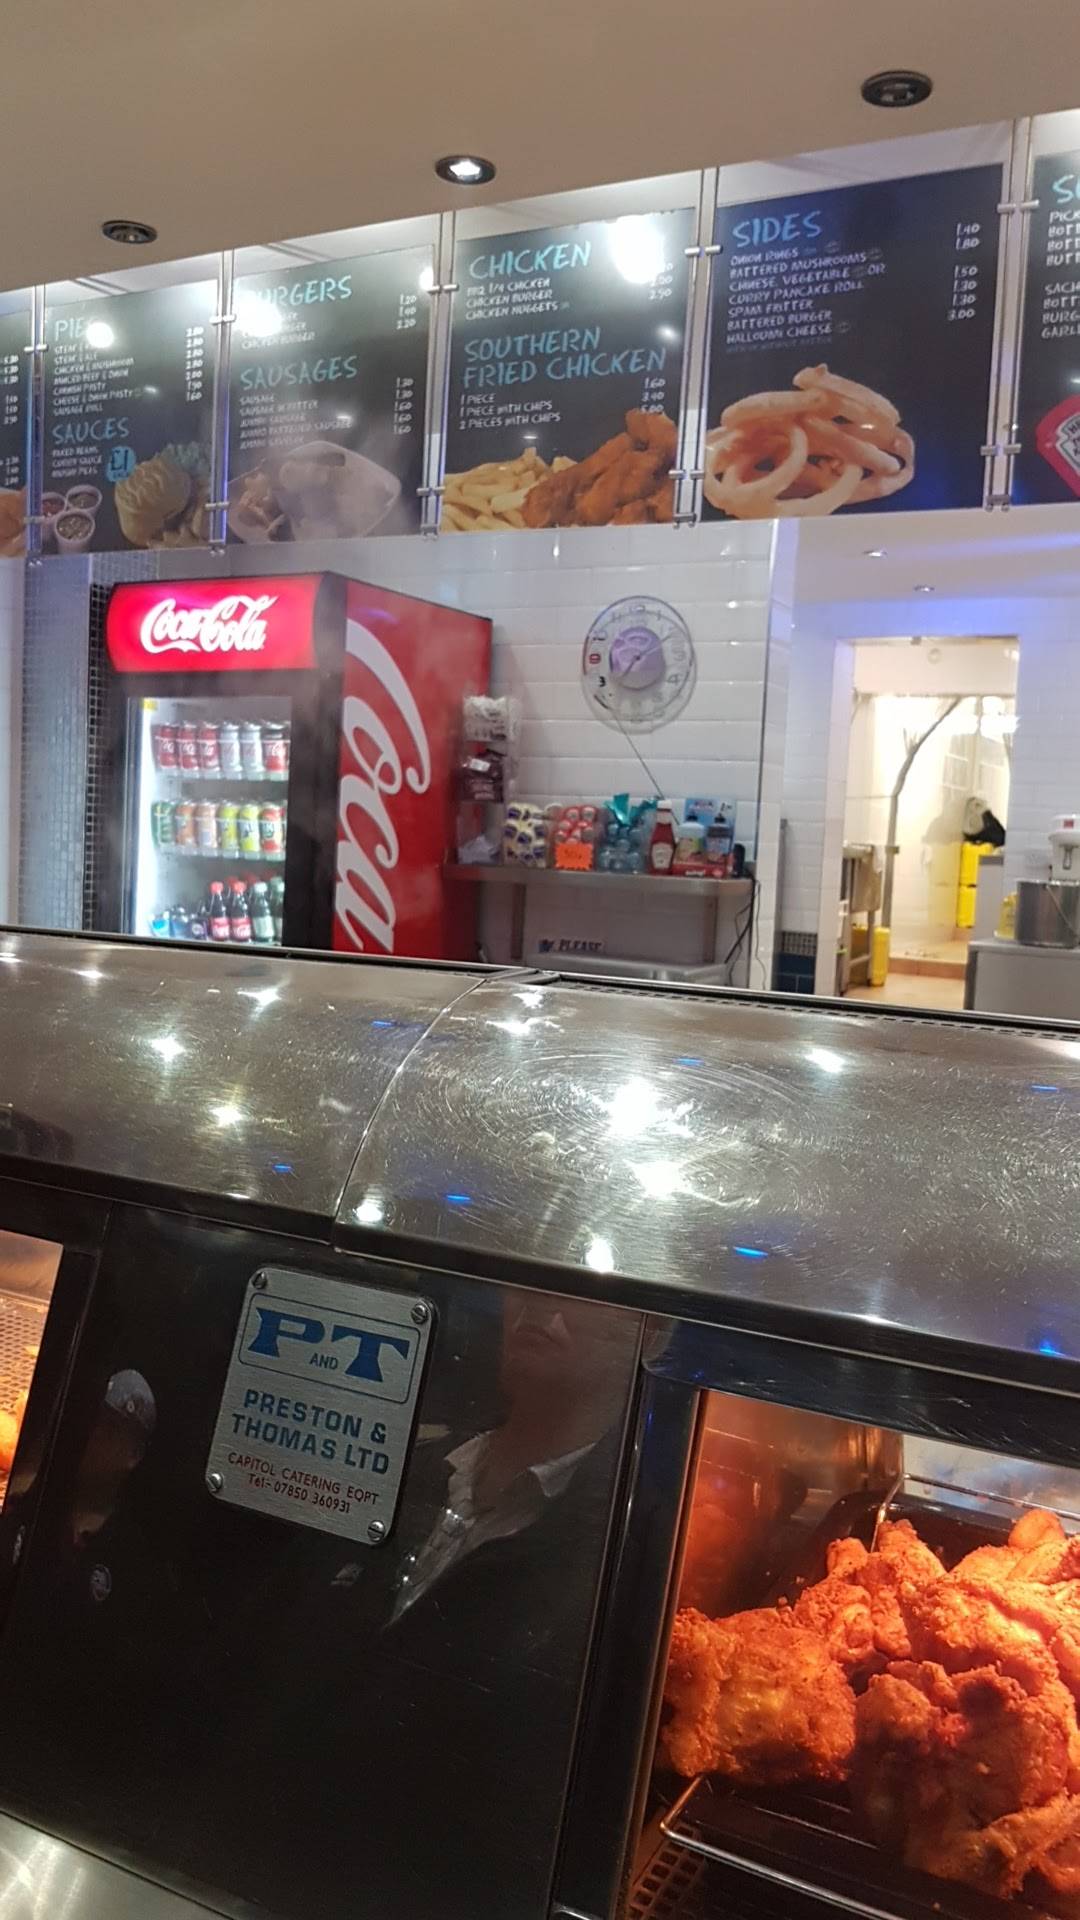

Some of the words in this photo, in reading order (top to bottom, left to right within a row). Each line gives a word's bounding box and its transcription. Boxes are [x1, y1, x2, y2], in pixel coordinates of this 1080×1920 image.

[733, 211, 822, 248] SIDES
[956, 223, 981, 236] 1.40
[956, 237, 980, 251] 1.80
[470, 240, 592, 279] CHICKEN
[730, 262, 788, 280] BATTERED
[791, 252, 867, 271] MUSHROOMS
[731, 253, 762, 266] ONION
[765, 247, 799, 262] RINGS
[729, 277, 776, 292] CHINESE
[782, 268, 850, 285] VEGETABLE
[867, 263, 886, 275] OR
[954, 265, 979, 279] 1.50
[247, 275, 352, 308] URGERS
[507, 277, 551, 292] CHICKEN
[729, 292, 771, 305] CURRY
[774, 283, 831, 300] PANCAKE
[834, 281, 864, 293] ROLL
[953, 280, 978, 293] 1.30
[466, 294, 510, 308] CHICKEN
[511, 289, 553, 303] BURGER
[728, 305, 763, 318] SPAM
[766, 299, 814, 315] FRITTER
[952, 294, 977, 307] 1.30
[466, 306, 510, 320] CHICKEN
[511, 302, 559, 316] NUGGETS
[727, 316, 785, 331] BATTERED
[788, 310, 833, 324] BURGER
[948, 309, 976, 321] 3.00
[727, 330, 783, 345] HALLOUMI
[787, 322, 833, 338] CHEESE
[465, 327, 601, 363] SOUTHERN
[240, 356, 358, 390] SAUSAGES
[464, 361, 538, 388] FRIED
[546, 349, 666, 380] CHICKEN
[467, 394, 496, 405] PIECE
[467, 405, 495, 416] PIECE
[497, 403, 522, 415] WITH
[524, 400, 553, 412] CHIPS
[52, 417, 129, 445] SAUCES
[468, 416, 502, 429] PIECES
[505, 415, 530, 427] WITH
[531, 412, 561, 425] CHIPS
[140, 594, 279, 654] Coca-Cola
[310, 1352, 340, 1371] AND
[244, 1389, 363, 1439] PRESTON
[370, 1422, 387, 1445] &
[232, 1413, 338, 1461] THOMAS
[345, 1444, 389, 1475] LTD
[228, 1452, 276, 1477] CAPITOL
[282, 1467, 341, 1495] CATERING
[274, 1482, 308, 1501] 07850
[312, 1493, 351, 1514] 360931
